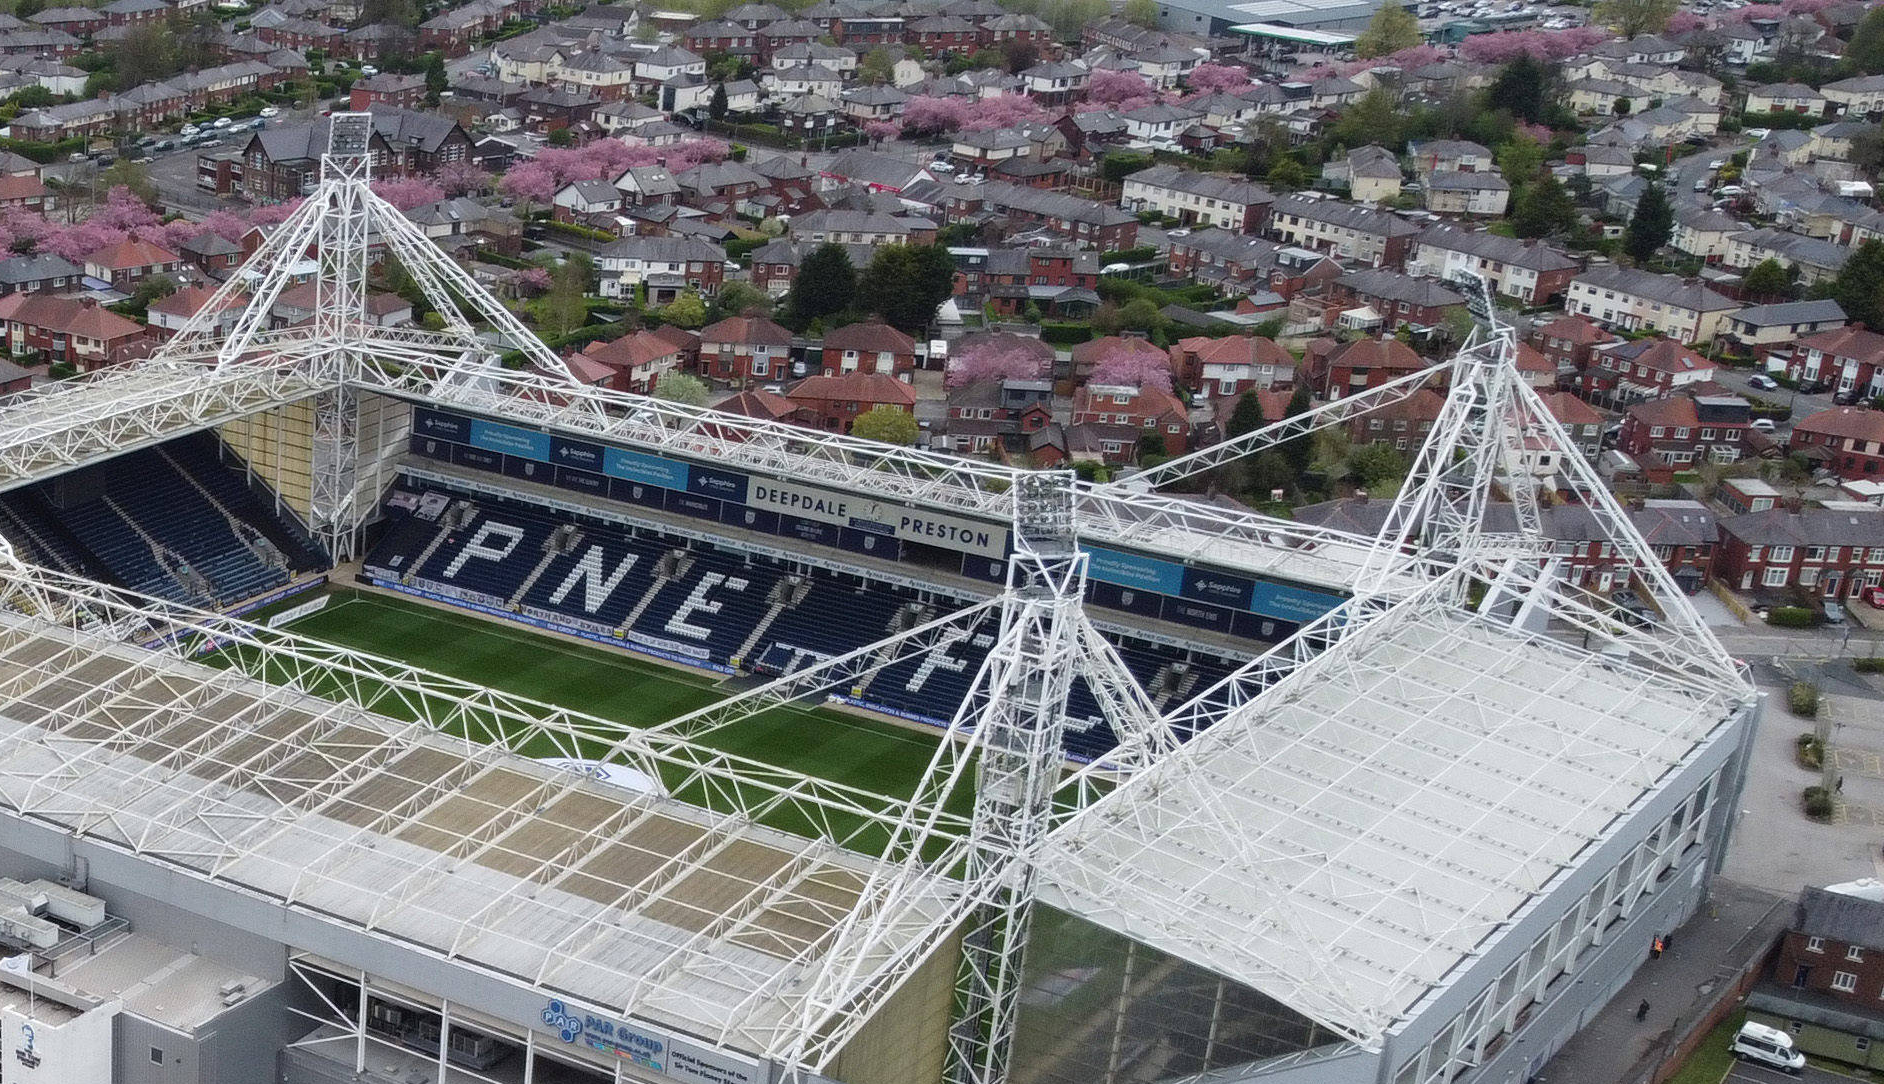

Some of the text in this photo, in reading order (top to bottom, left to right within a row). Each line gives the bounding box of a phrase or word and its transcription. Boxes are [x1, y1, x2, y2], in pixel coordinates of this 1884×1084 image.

[756, 485, 847, 518] DEEPDALE
[901, 516, 990, 548] PRESTON
[1208, 581, 1241, 595] Sapphire
[586, 1014, 613, 1037] PAR
[617, 1026, 664, 1053] Group
[672, 1050, 696, 1066] Official
[697, 1057, 727, 1075] Sponsors
[685, 1064, 699, 1075] Tom
[700, 1068, 723, 1083] Finney
